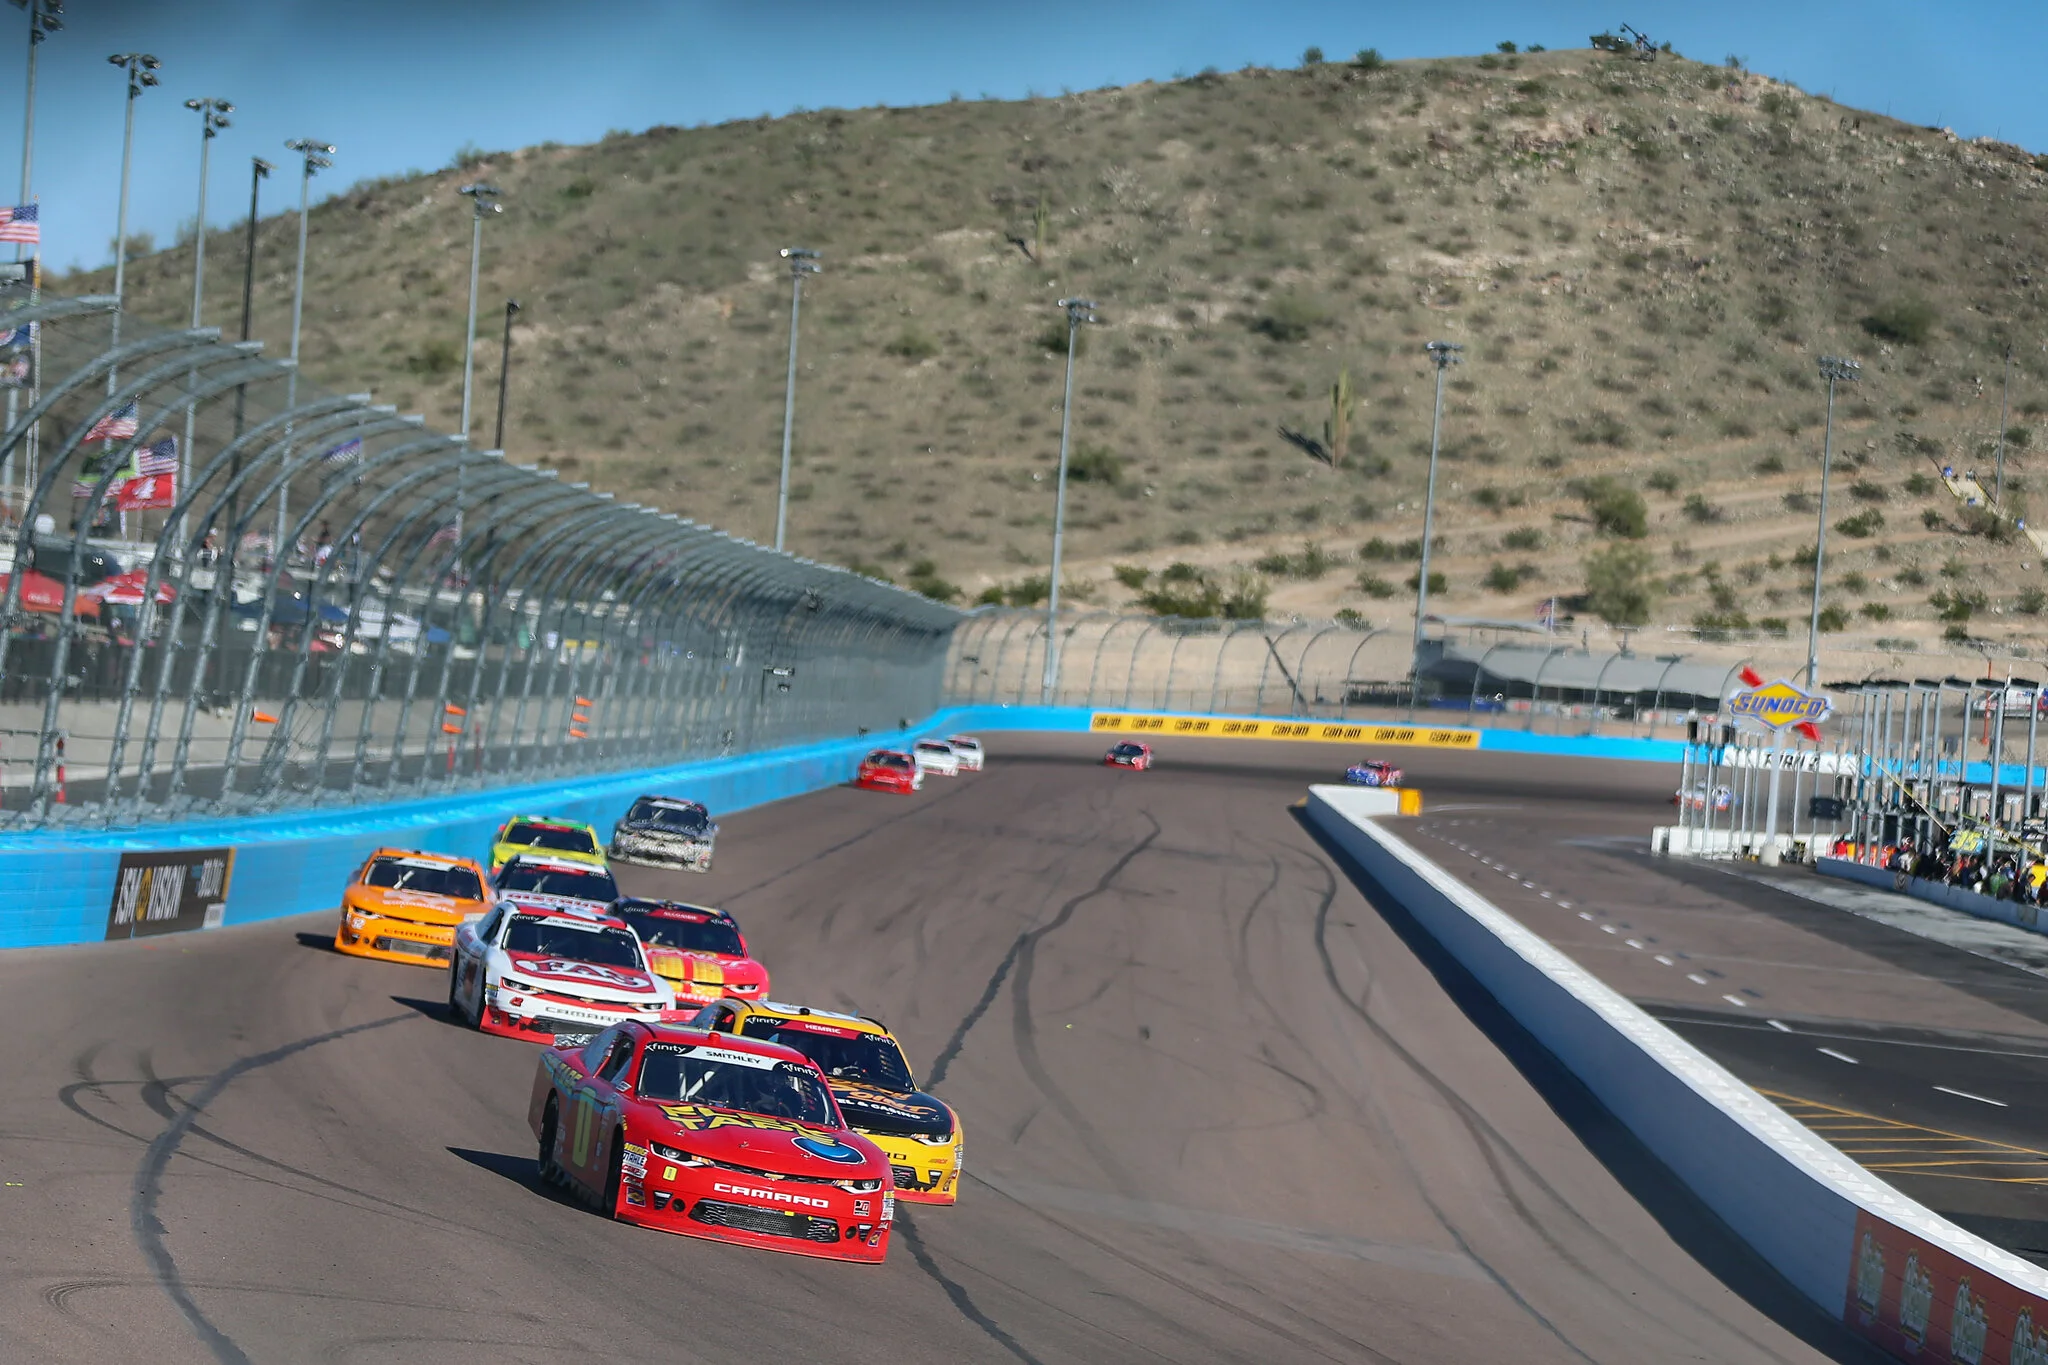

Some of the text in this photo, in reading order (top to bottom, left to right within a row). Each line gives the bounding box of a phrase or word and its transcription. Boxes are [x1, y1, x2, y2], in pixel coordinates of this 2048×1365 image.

[1736, 694, 1824, 716] SUNOCO
[545, 1006, 626, 1023] CAMARO
[745, 1016, 781, 1026] xfinity
[804, 1023, 842, 1034] HEMRIC
[864, 1033, 897, 1047] xfinity
[644, 1042, 686, 1054] xfinity
[706, 1051, 761, 1064] SMITHLEY
[781, 1063, 820, 1078] xfinity
[713, 1182, 829, 1209] CAMARO
